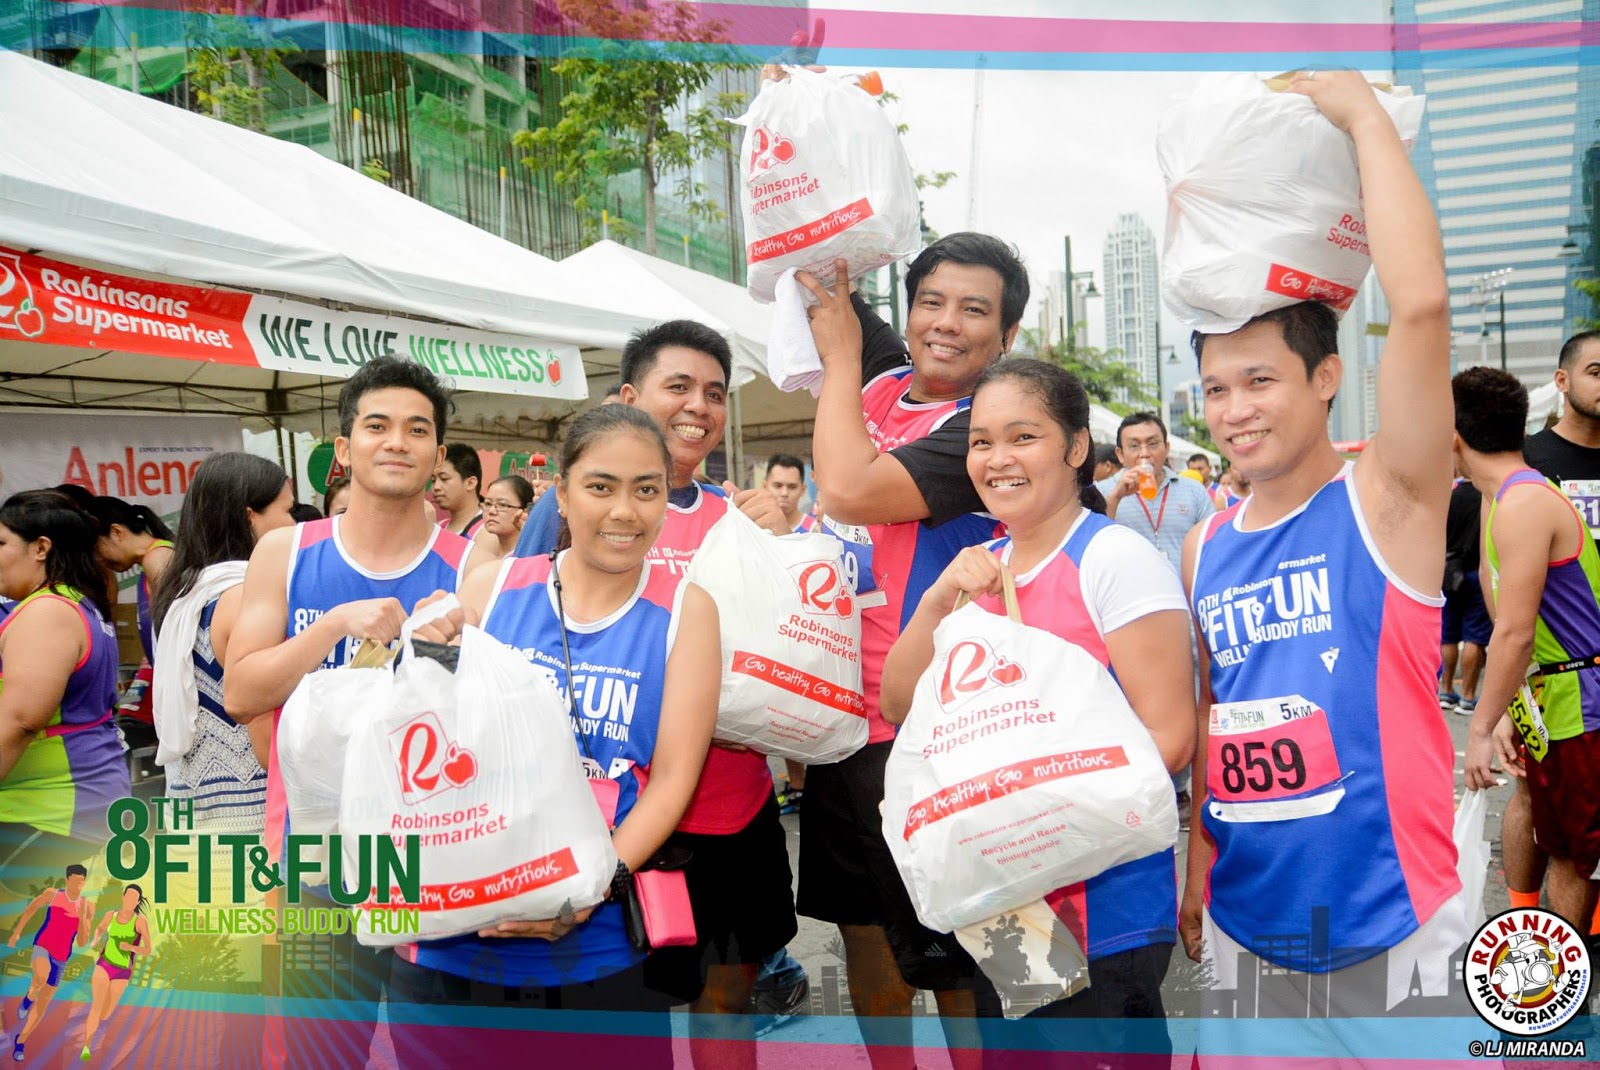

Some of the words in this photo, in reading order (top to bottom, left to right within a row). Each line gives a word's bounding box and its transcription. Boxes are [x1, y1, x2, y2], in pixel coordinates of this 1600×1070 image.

[786, 232, 804, 245] Go
[41, 268, 189, 319] Robinsons
[1280, 272, 1302, 289] Go
[52, 296, 233, 349] Supermarket
[260, 313, 321, 361] WE
[325, 322, 398, 366] LOVE
[409, 335, 544, 384] WELLNESS
[1278, 553, 1327, 570] ermarket
[778, 624, 858, 663] Supermarket
[789, 614, 854, 647] Robinsons
[1302, 614, 1332, 635] RUN
[580, 661, 641, 680] Supermarket
[745, 656, 766, 672] Go
[813, 682, 831, 697] Go
[603, 720, 629, 742] RUN
[932, 698, 1040, 740] Robinsons
[1280, 703, 1312, 721] 5KM
[1510, 697, 1541, 752] 542
[922, 710, 1056, 760] Supermarket
[1221, 738, 1307, 793] 859
[391, 802, 489, 830] Robinsons
[907, 807, 926, 826] Go
[995, 768, 1023, 787] Go
[980, 840, 1017, 857] Recycle
[1018, 833, 1036, 846] and
[1037, 823, 1067, 840] Reuse
[448, 885, 475, 902] Go
[485, 857, 562, 897] nutritious.
